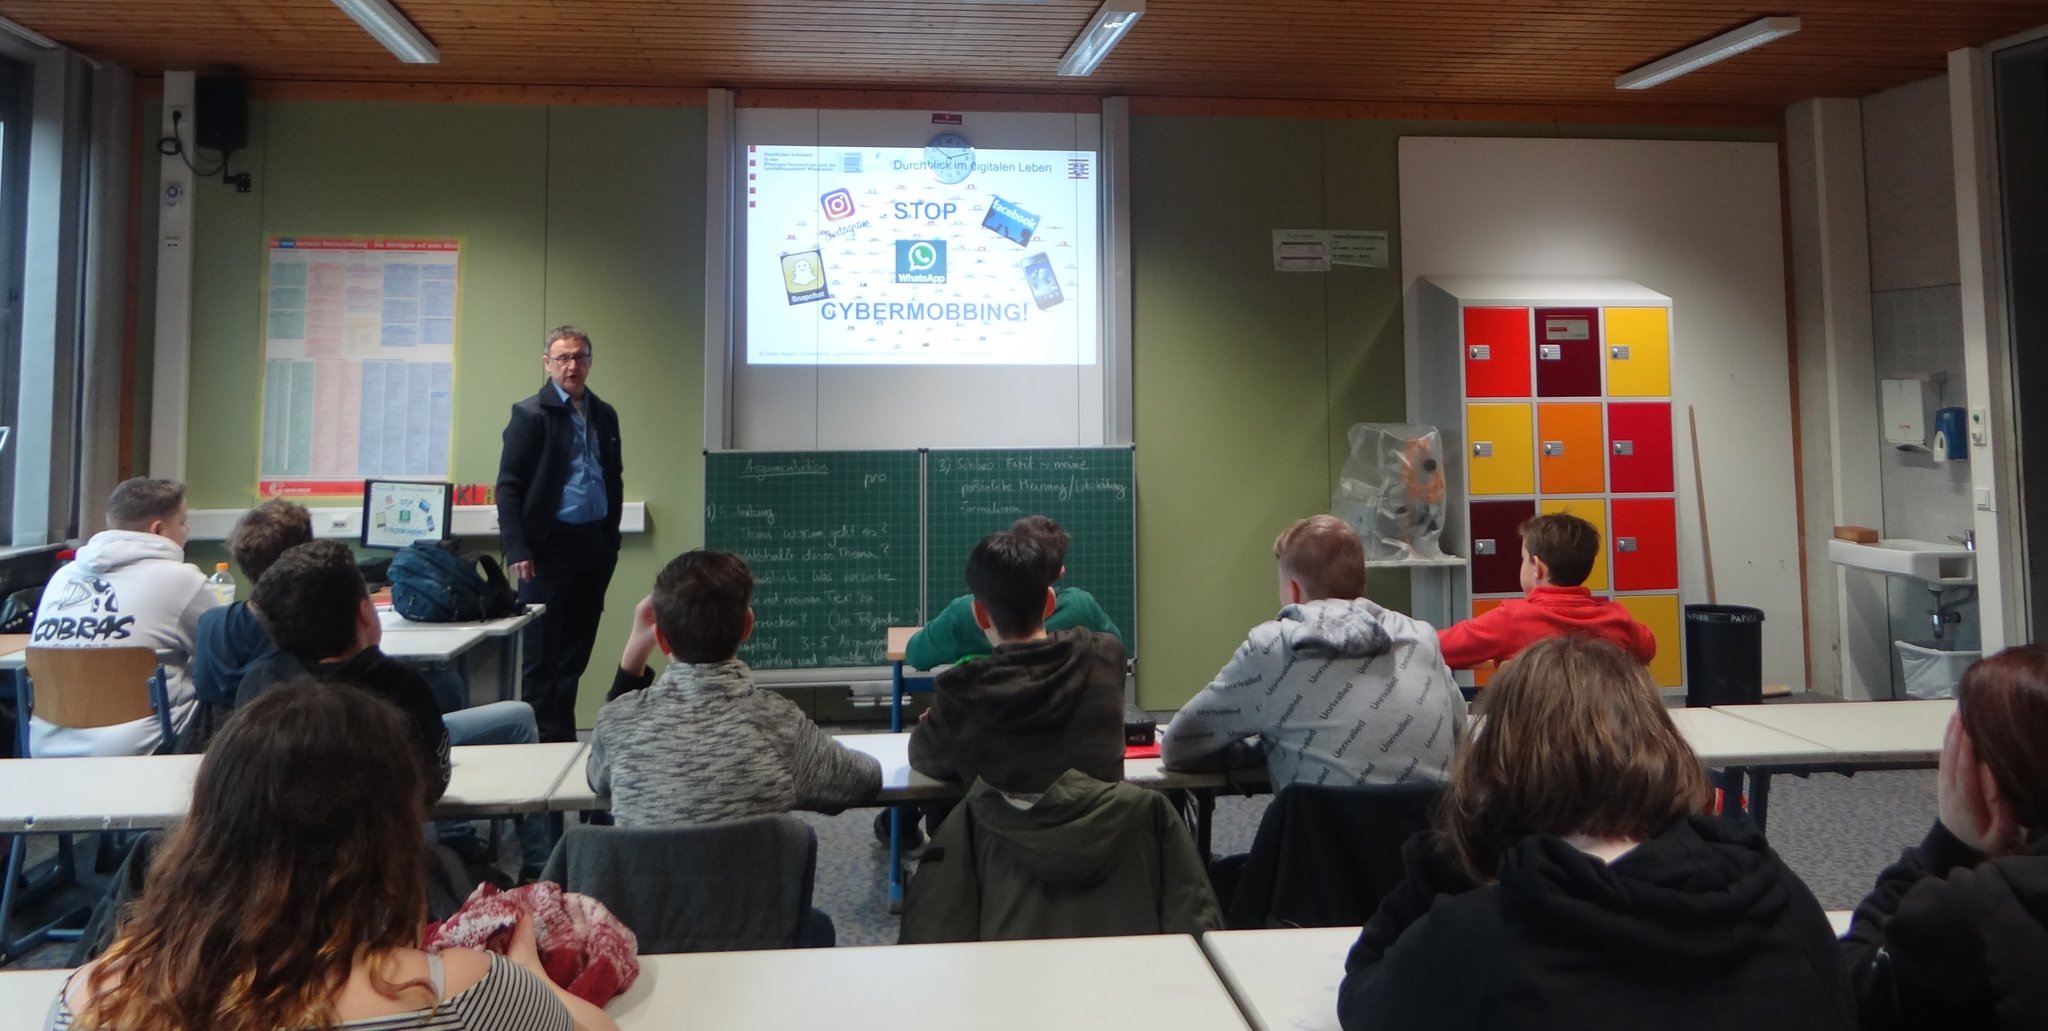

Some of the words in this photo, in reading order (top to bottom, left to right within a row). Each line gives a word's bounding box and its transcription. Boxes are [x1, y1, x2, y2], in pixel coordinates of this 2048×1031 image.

[893, 159, 952, 171] Durchblick
[954, 160, 968, 170] im
[970, 161, 1015, 174] digitalen
[1018, 161, 1052, 173] Leben
[894, 202, 957, 220] STOP
[992, 200, 1038, 230] facebook
[898, 273, 945, 283] WhatsApp
[791, 291, 826, 304] Snapchat
[821, 302, 1028, 321] CYBERMOBBING!
[864, 473, 888, 489] pro
[34, 615, 136, 642] COBRAS
[1265, 655, 1297, 697] Unrivalled
[1319, 682, 1354, 720] Unrivalled
[1370, 676, 1399, 710] Unrivalled
[1274, 694, 1303, 728] Unrivalled
[1332, 719, 1366, 759] Unrivalled
[1380, 714, 1414, 752] Unrivalled
